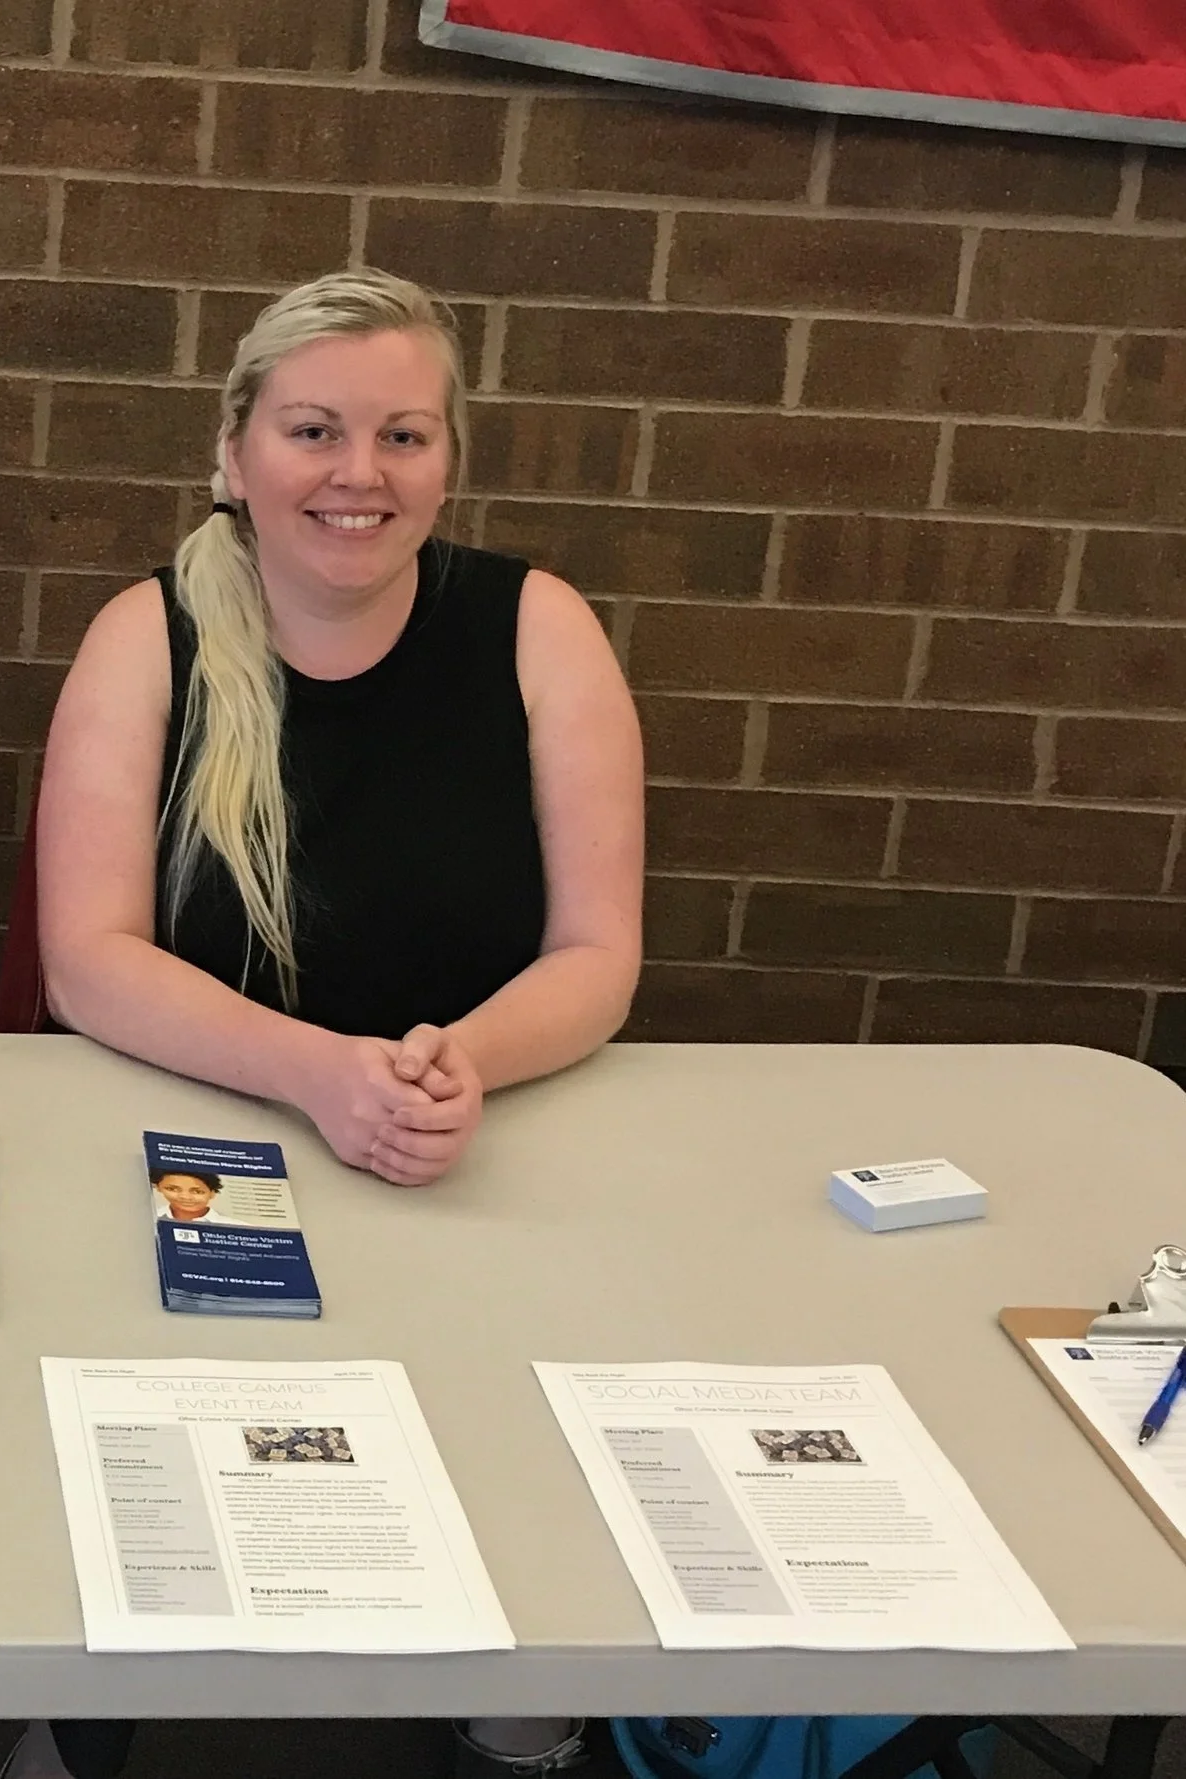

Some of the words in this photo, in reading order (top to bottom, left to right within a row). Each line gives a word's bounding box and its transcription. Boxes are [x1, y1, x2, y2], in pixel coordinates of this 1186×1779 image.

[136, 1379, 233, 1393] COLLEGE
[238, 1382, 327, 1394] CAMPUS
[587, 1385, 691, 1400] SOCIAL
[692, 1385, 782, 1401] MEDIA
[784, 1387, 862, 1402] TEAM
[174, 1398, 240, 1410] EVENT
[247, 1399, 303, 1411] TEAM
[785, 1559, 869, 1567] Expectations
[250, 1586, 329, 1595] Expectations
